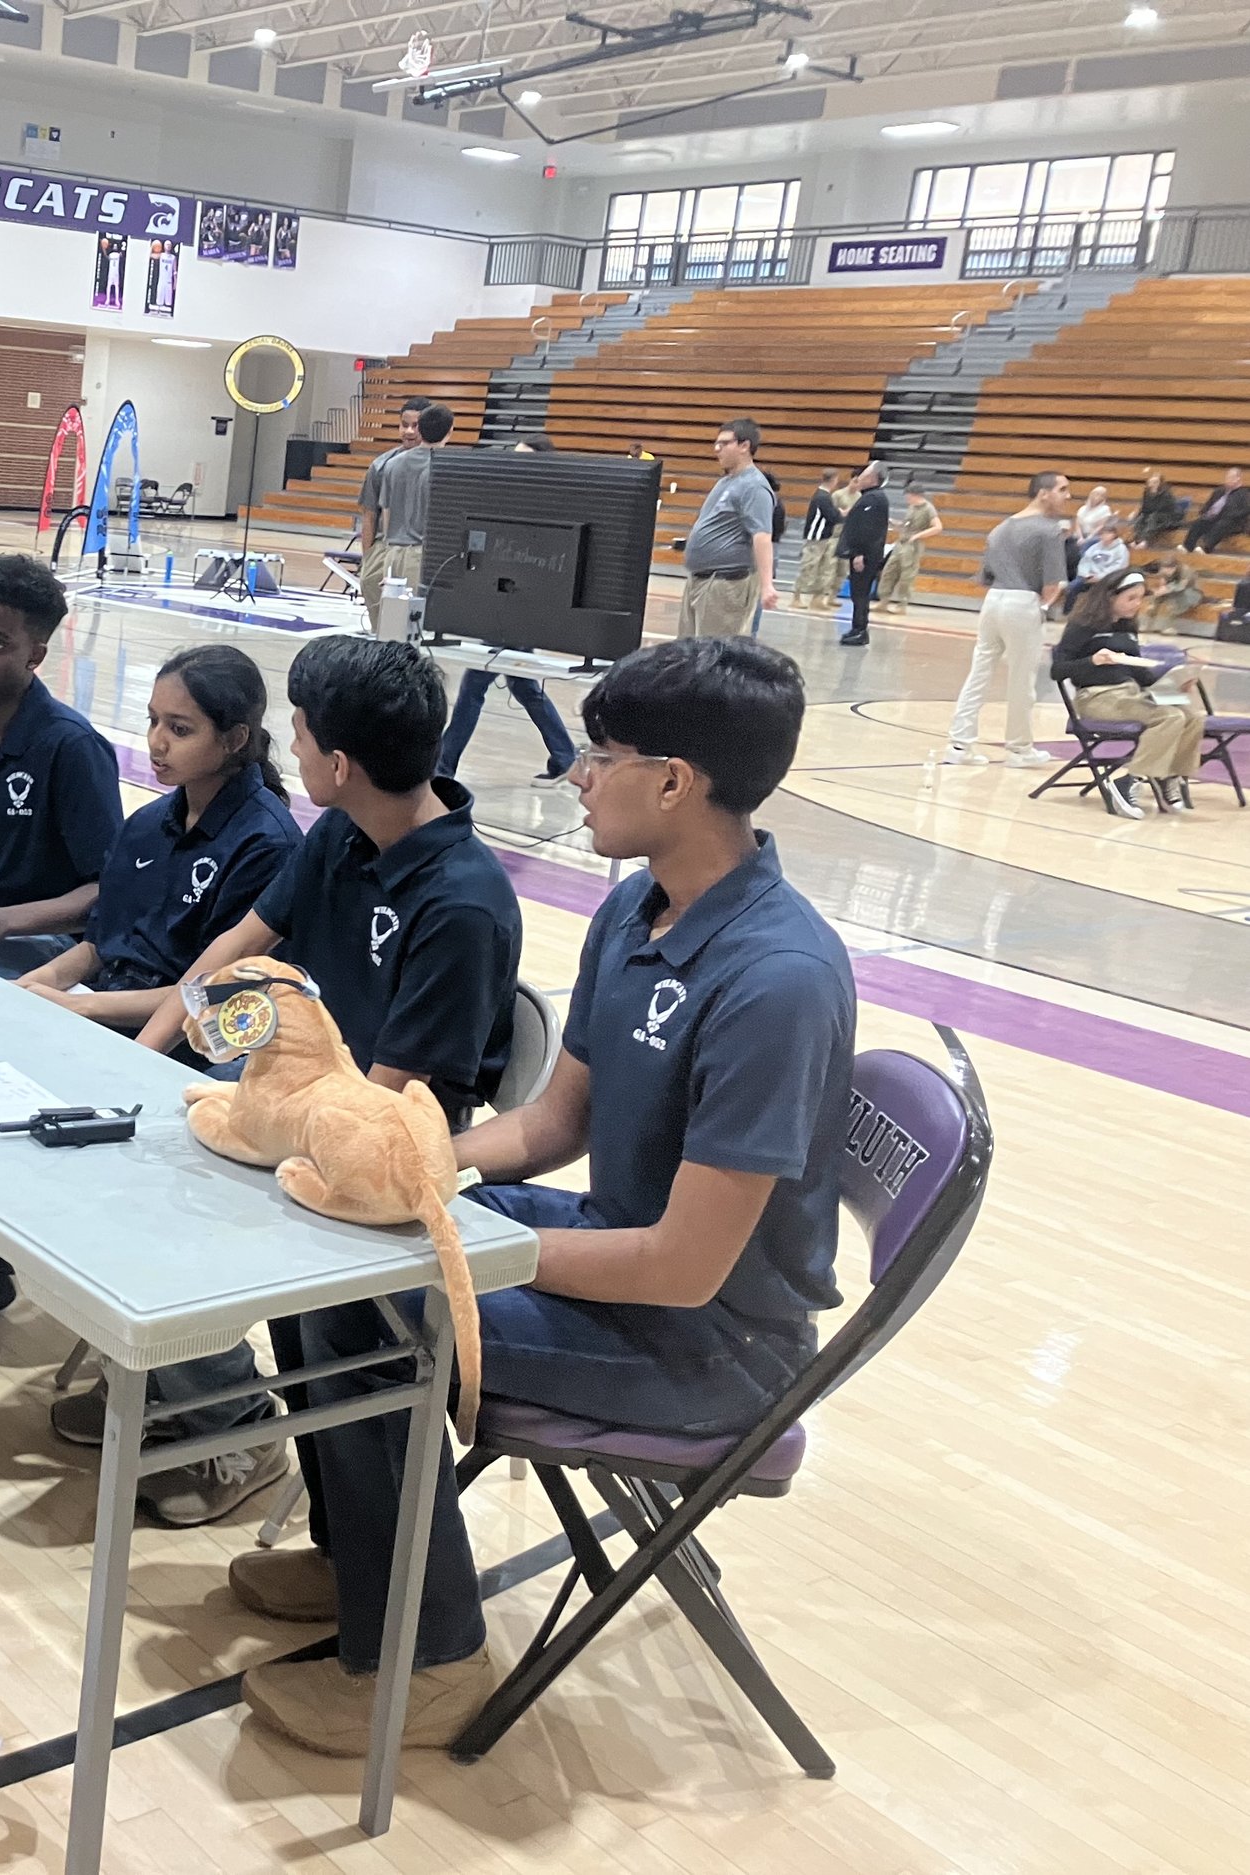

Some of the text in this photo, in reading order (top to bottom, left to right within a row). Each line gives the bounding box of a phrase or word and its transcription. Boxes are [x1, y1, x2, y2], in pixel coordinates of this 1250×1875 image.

[836, 244, 938, 266] HOME SEATING
[654, 978, 688, 1004] WILDCATS
